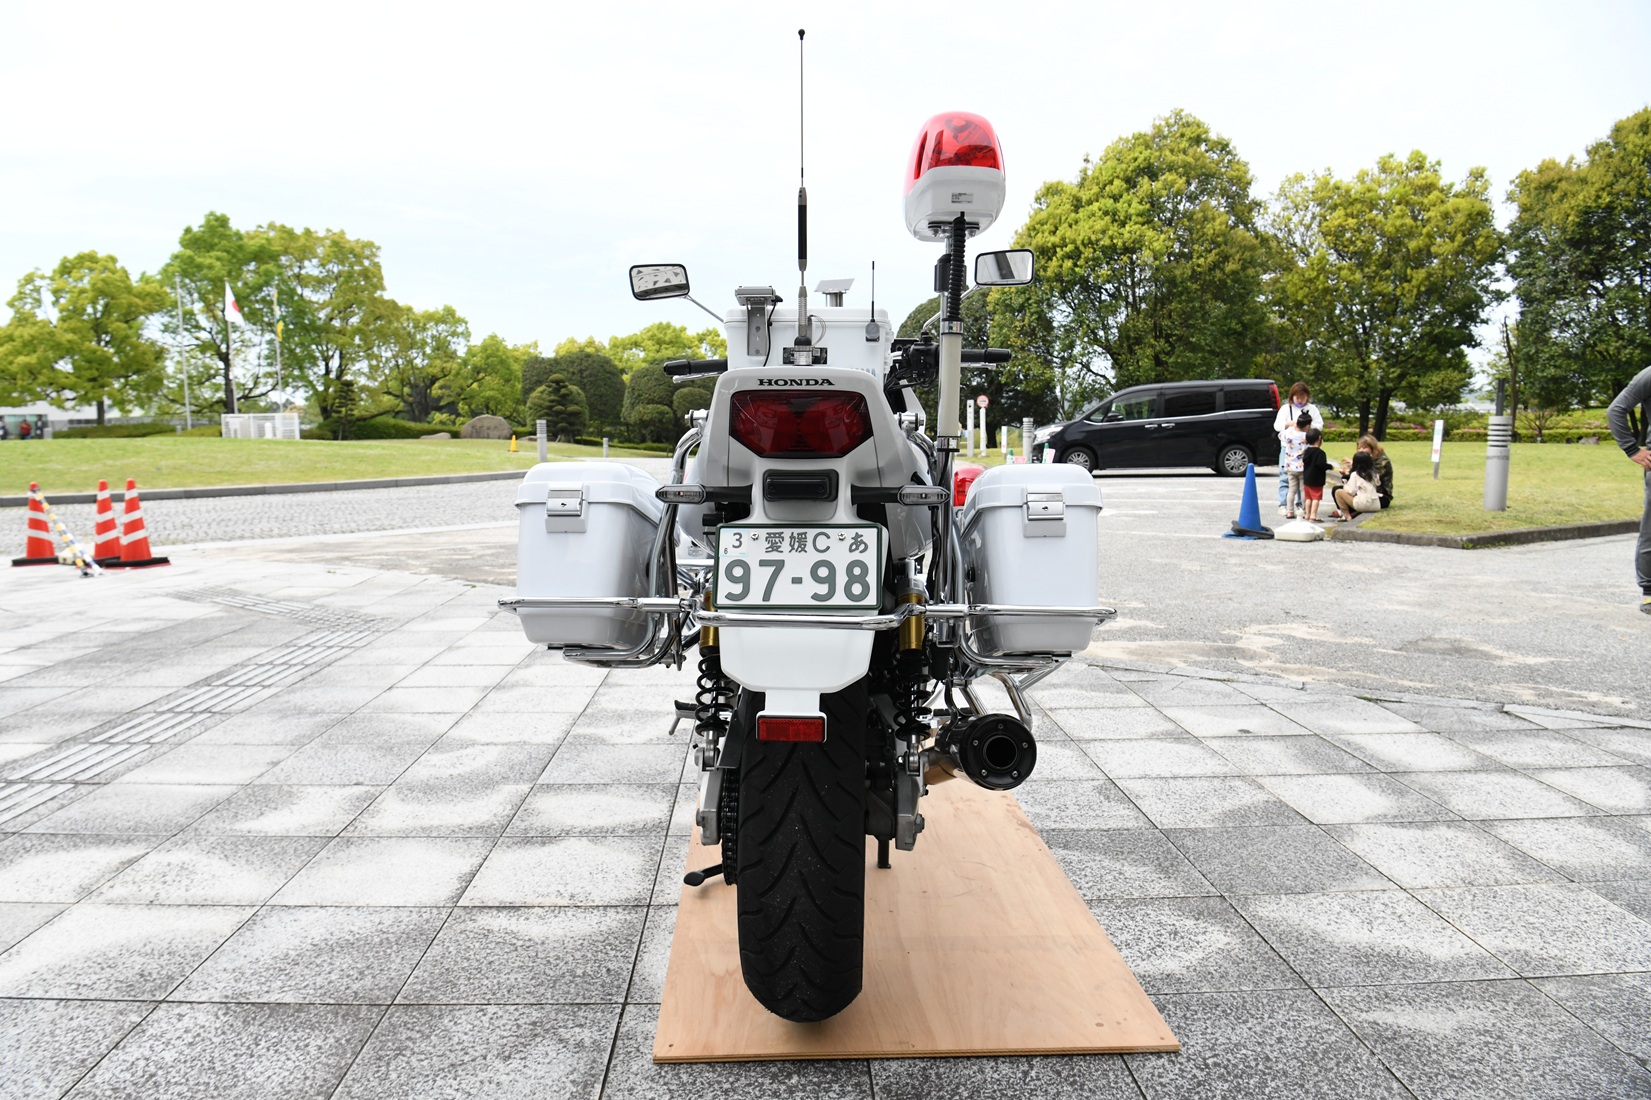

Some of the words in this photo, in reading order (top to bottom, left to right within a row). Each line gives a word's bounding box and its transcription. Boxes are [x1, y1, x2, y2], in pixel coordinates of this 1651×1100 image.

[757, 378, 835, 387] HONDA
[731, 532, 743, 549] 3
[723, 547, 729, 555] 6
[724, 558, 871, 602] 97-98
